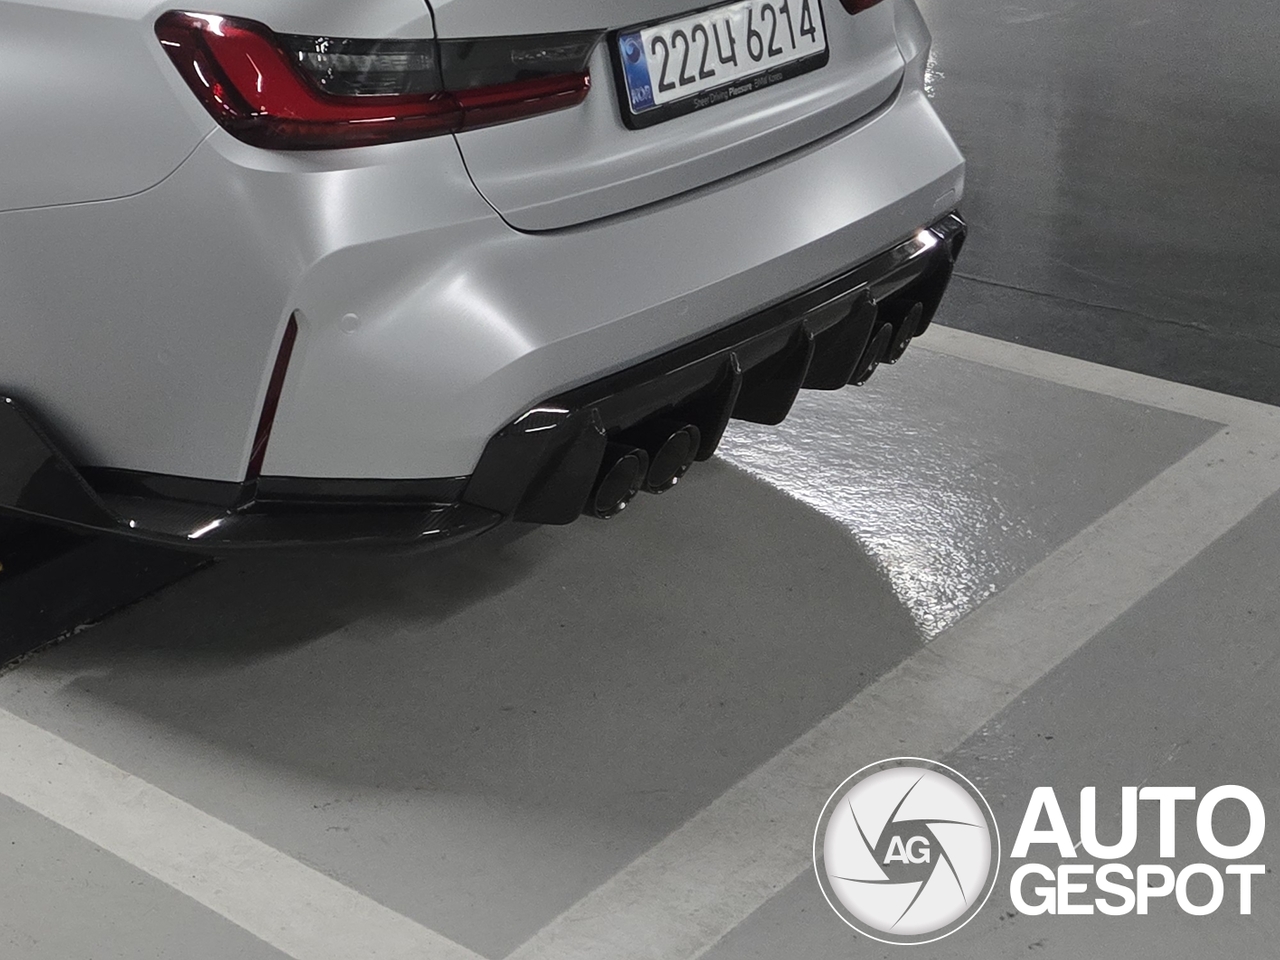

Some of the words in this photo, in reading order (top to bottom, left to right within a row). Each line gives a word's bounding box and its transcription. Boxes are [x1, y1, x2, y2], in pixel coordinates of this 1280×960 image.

[693, 97, 710, 109] Sheer
[709, 91, 729, 104] Driving
[728, 83, 752, 97] Pleasure
[753, 75, 768, 88] BMW
